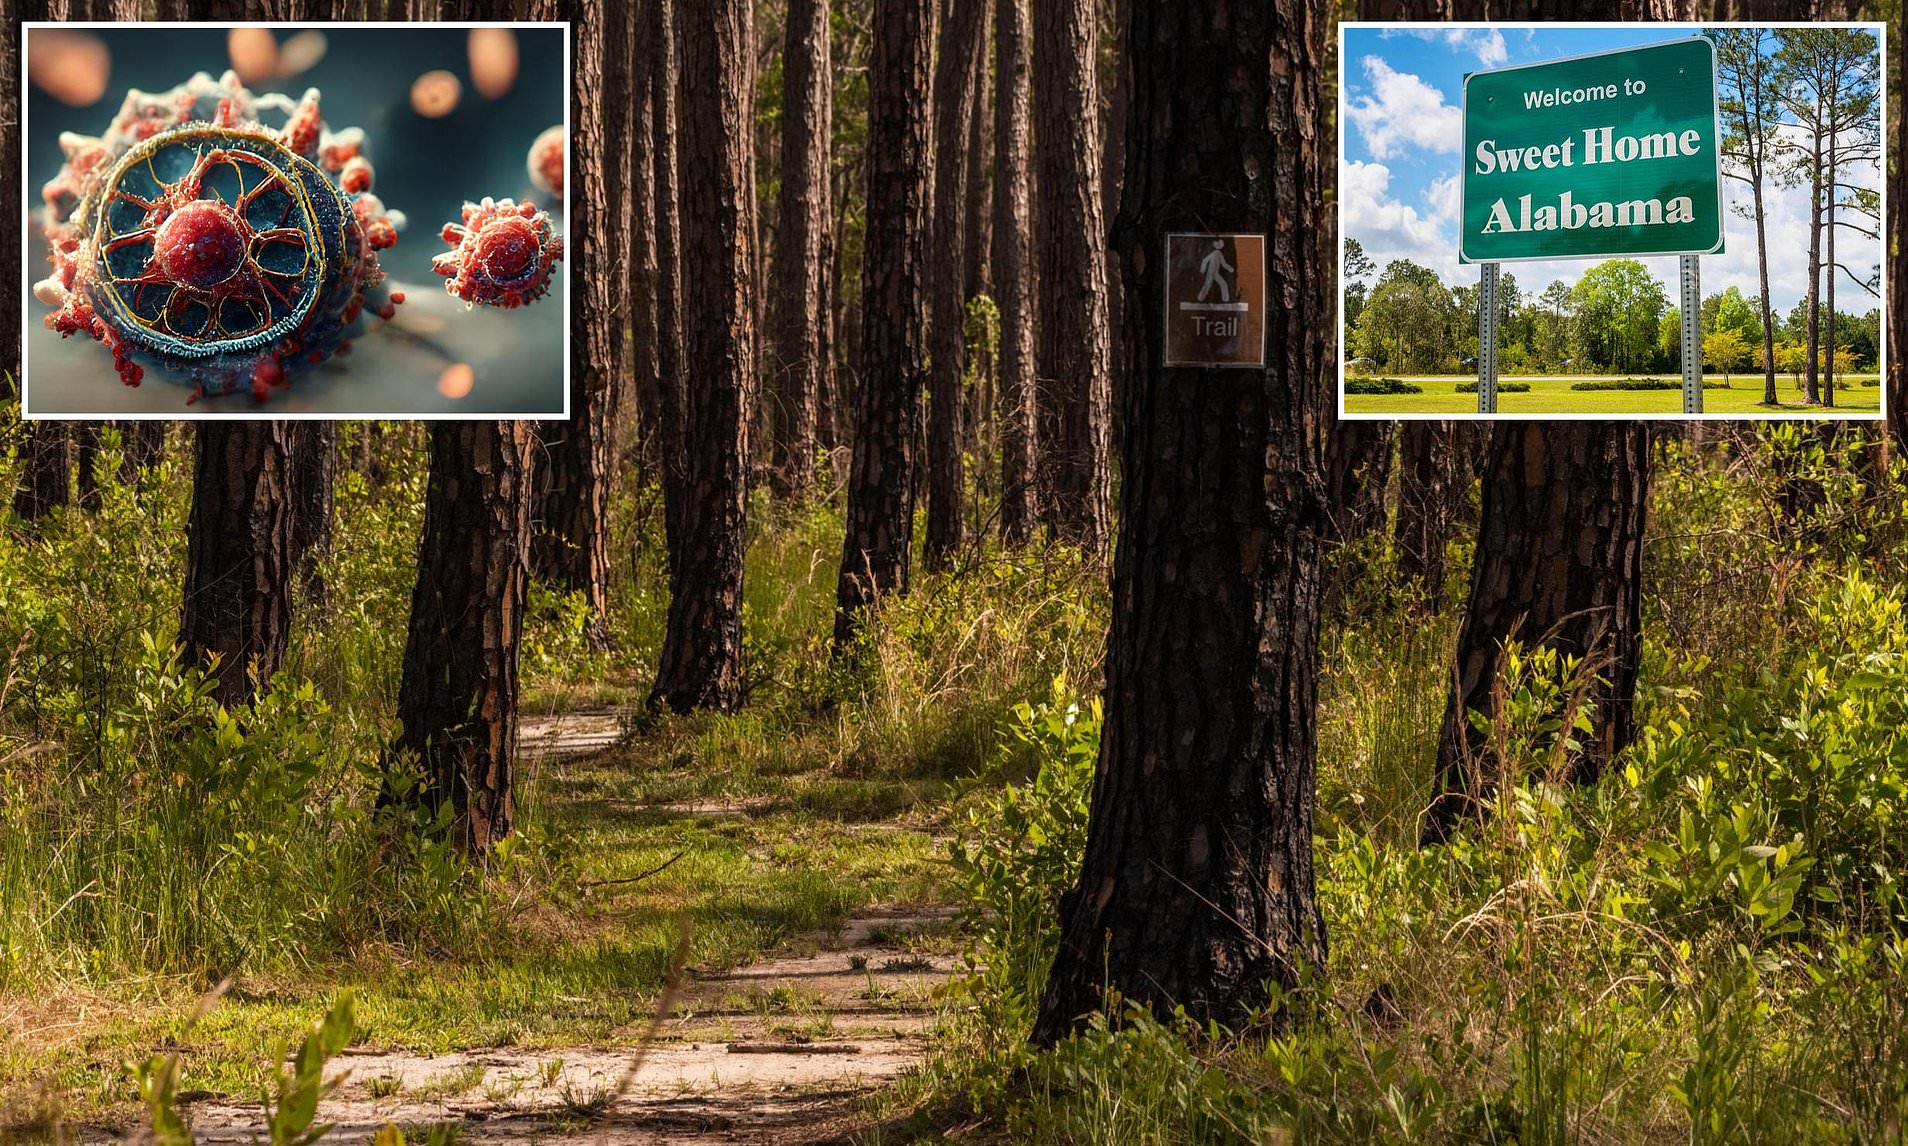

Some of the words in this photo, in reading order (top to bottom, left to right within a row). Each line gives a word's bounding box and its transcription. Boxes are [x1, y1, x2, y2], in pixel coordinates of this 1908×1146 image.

[1523, 84, 1618, 109] Welcome
[1624, 78, 1646, 96] to
[1475, 136, 1575, 175] Sweet
[1582, 126, 1701, 165] Home
[1480, 190, 1696, 234] Alabama
[1191, 316, 1238, 336] Trail
